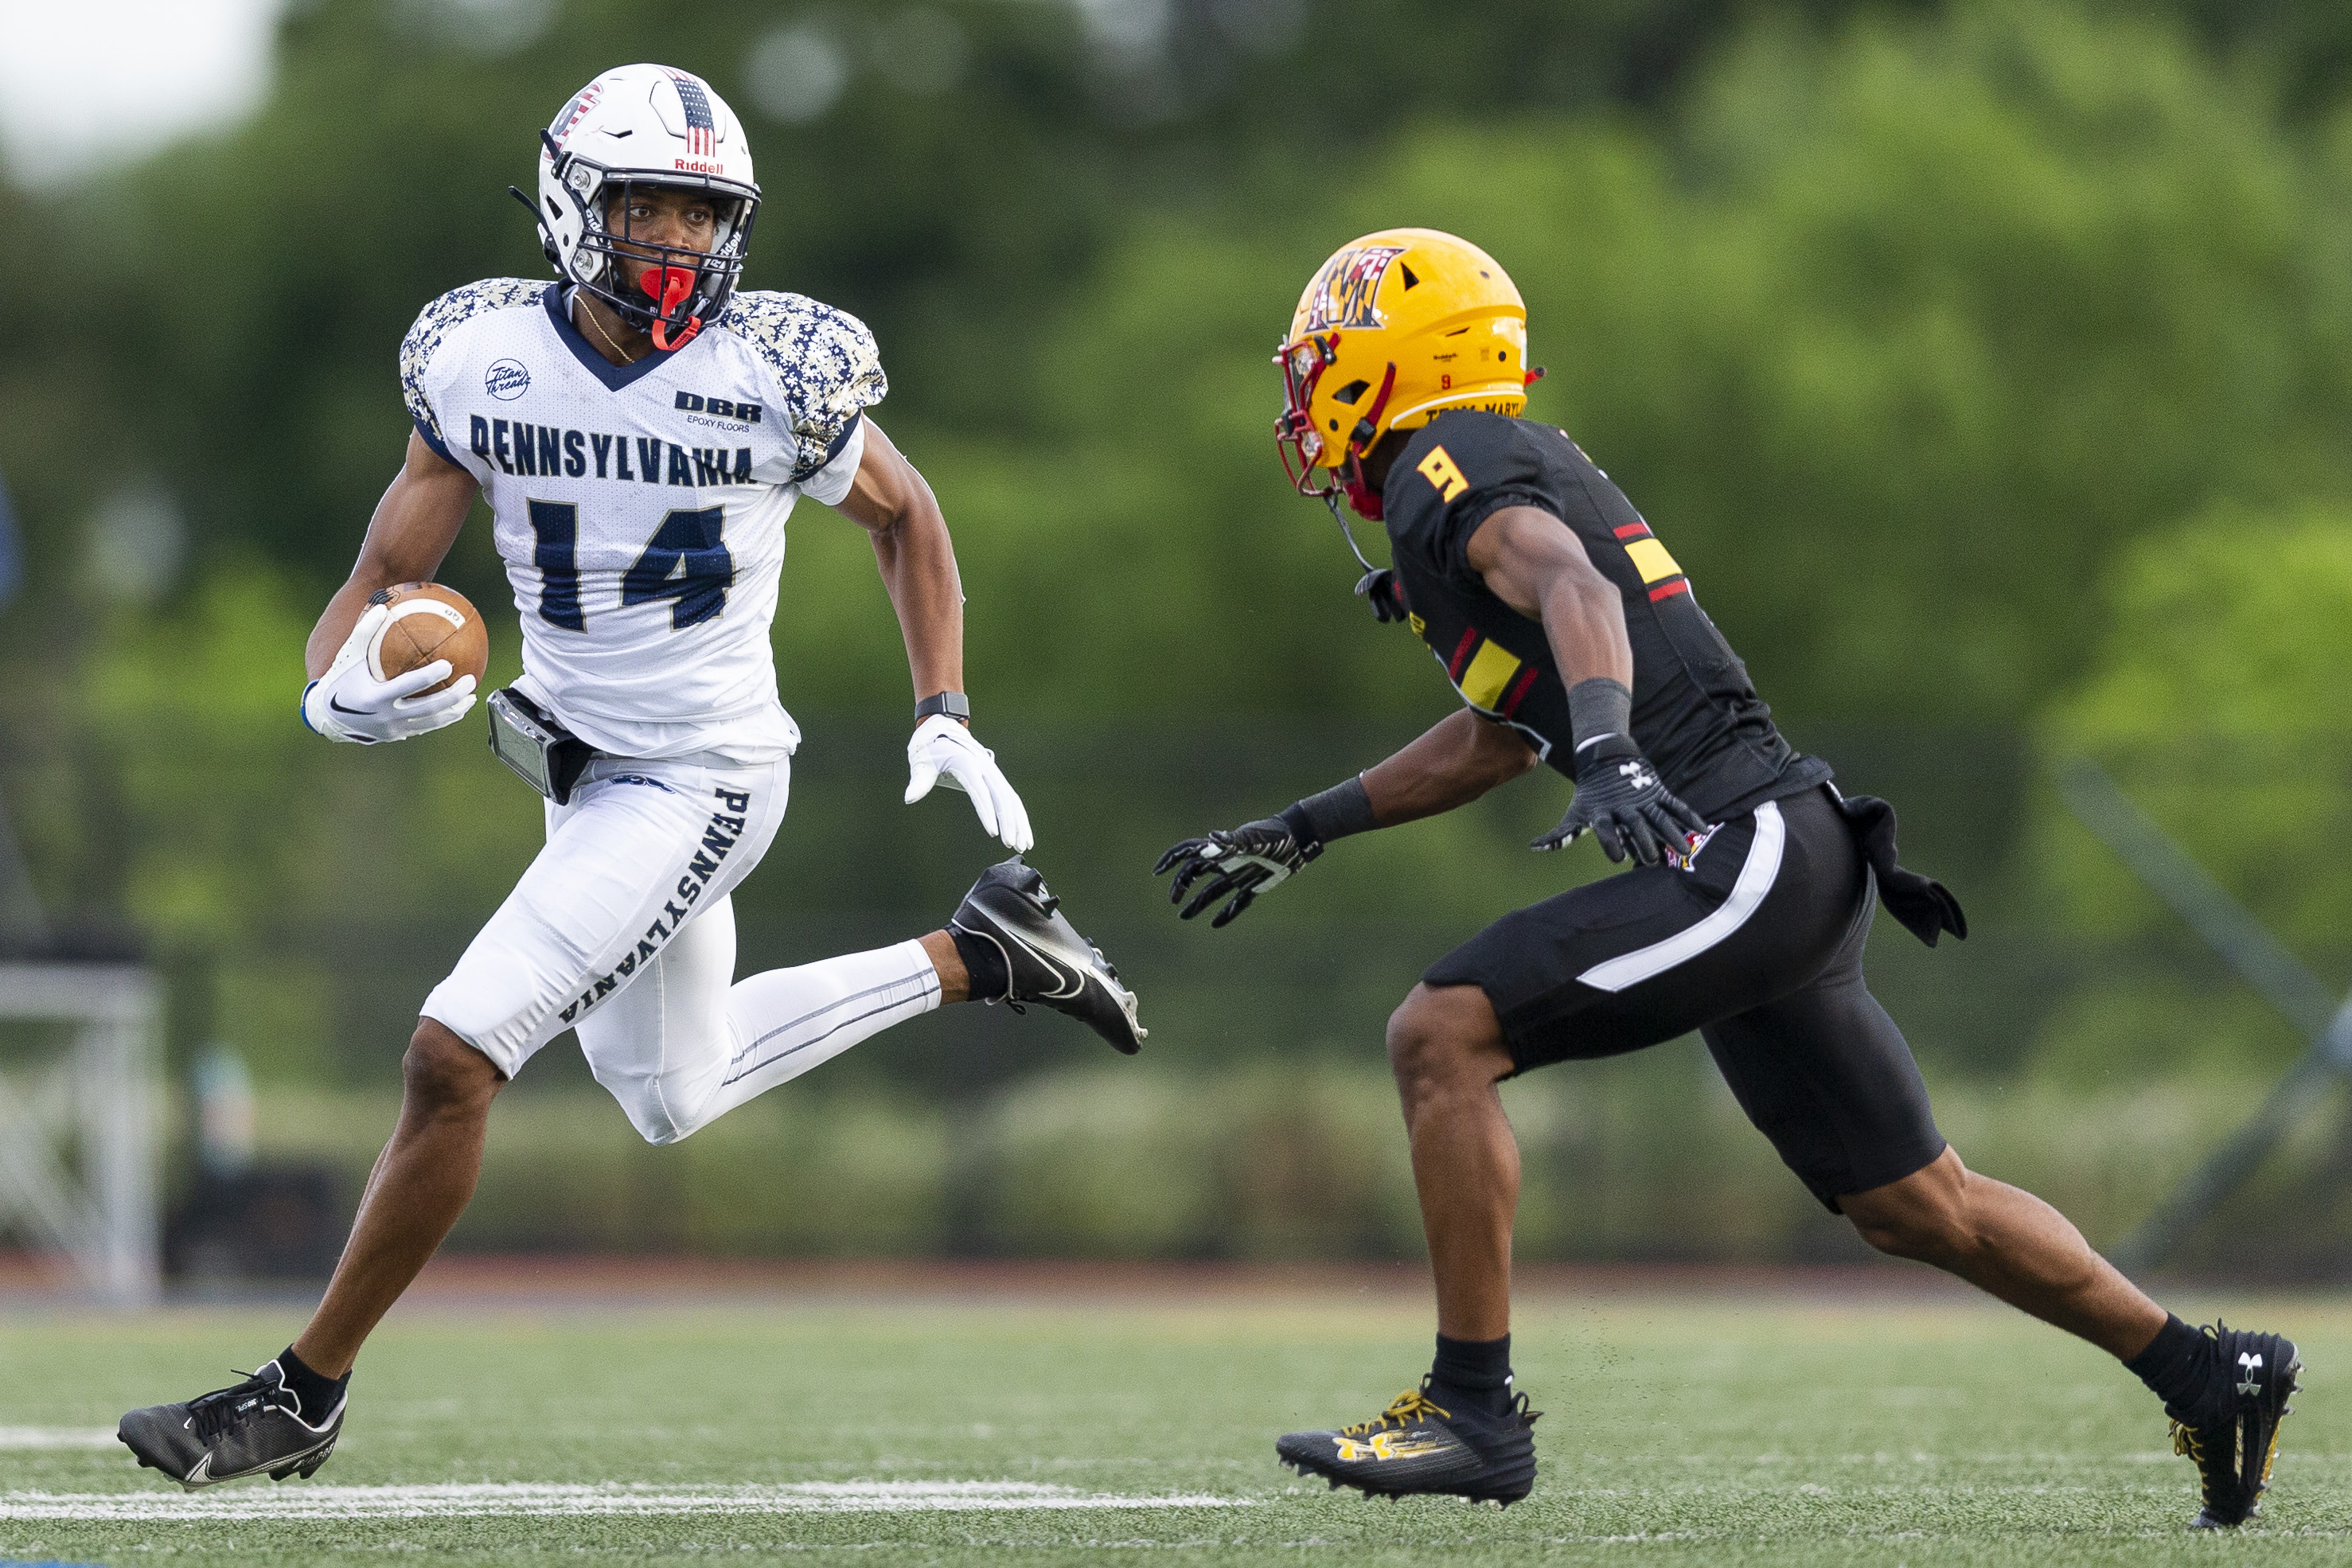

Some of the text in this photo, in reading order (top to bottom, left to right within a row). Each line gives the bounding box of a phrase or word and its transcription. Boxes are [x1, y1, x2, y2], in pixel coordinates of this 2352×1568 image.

[674, 158, 724, 174] Riddell
[709, 231, 742, 269] Rddell
[492, 366, 526, 381] Titan
[673, 390, 763, 424] DBR
[687, 414, 750, 433] EPOXY FLOORS
[469, 413, 759, 488] PENNSYLVANIA
[1415, 443, 1471, 505] 9
[525, 496, 737, 634] 14
[557, 786, 751, 1025] PENNSYLVANIA
